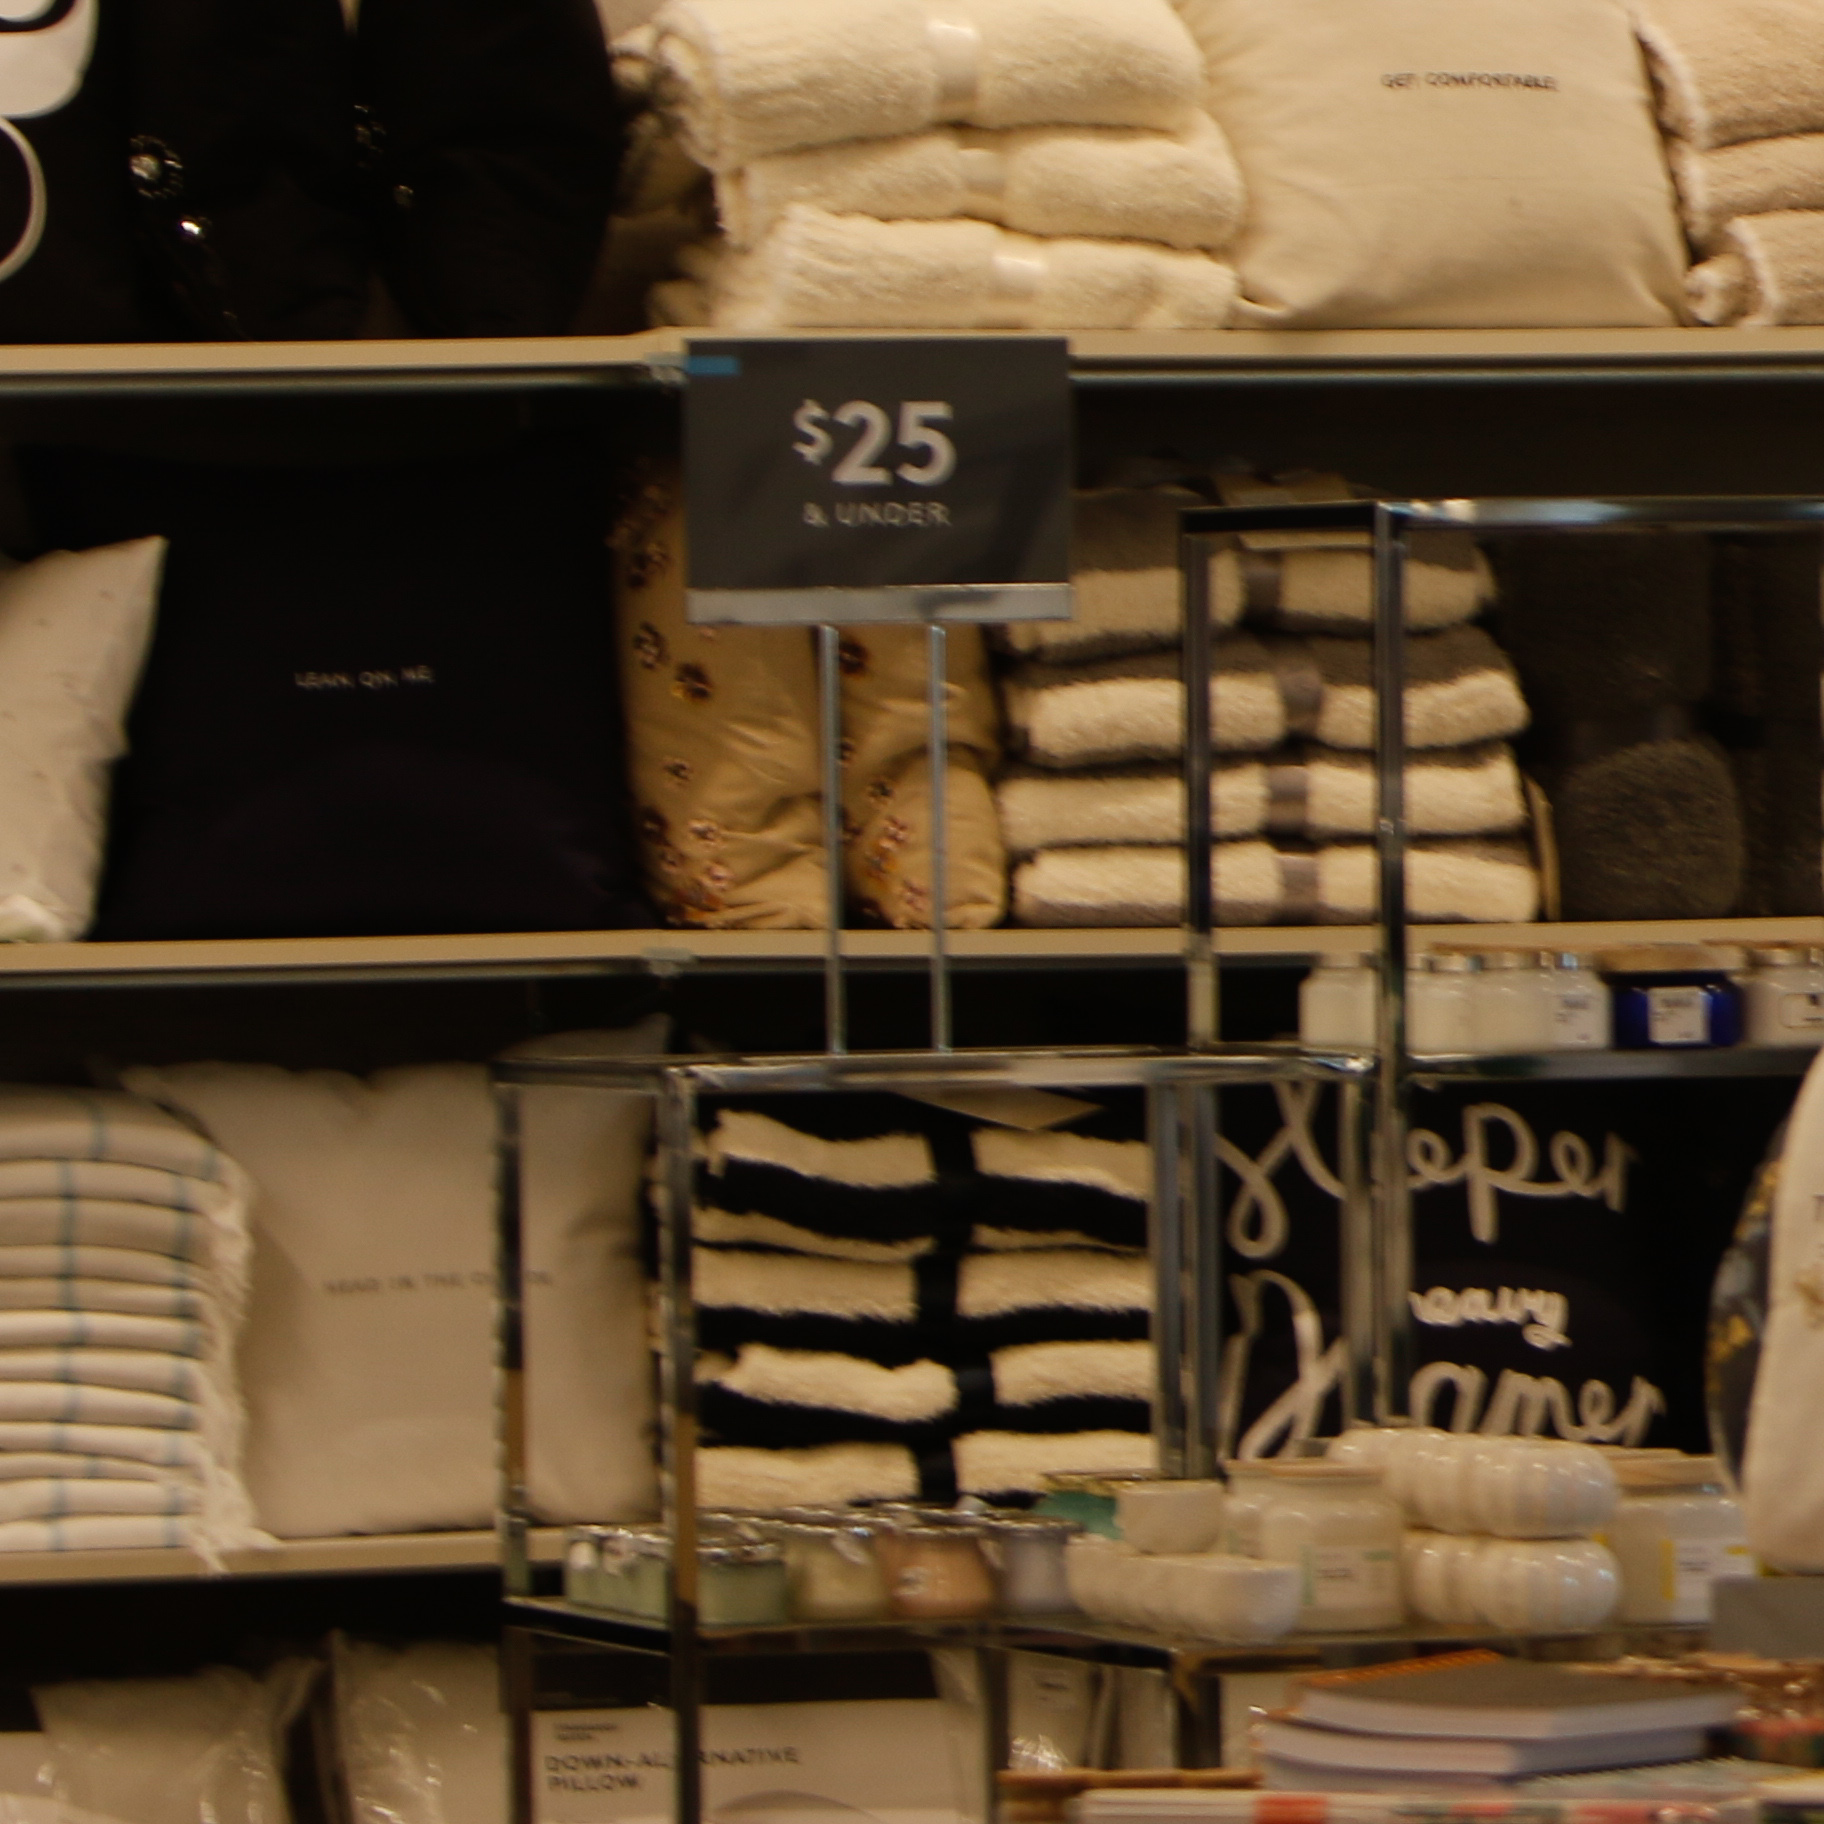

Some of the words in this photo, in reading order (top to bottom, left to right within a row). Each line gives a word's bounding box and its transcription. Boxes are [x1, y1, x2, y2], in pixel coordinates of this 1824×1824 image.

[791, 398, 957, 486] $25
[802, 502, 829, 527] &
[835, 501, 952, 527] UNDER
[548, 1773, 641, 1793] PILLOW
